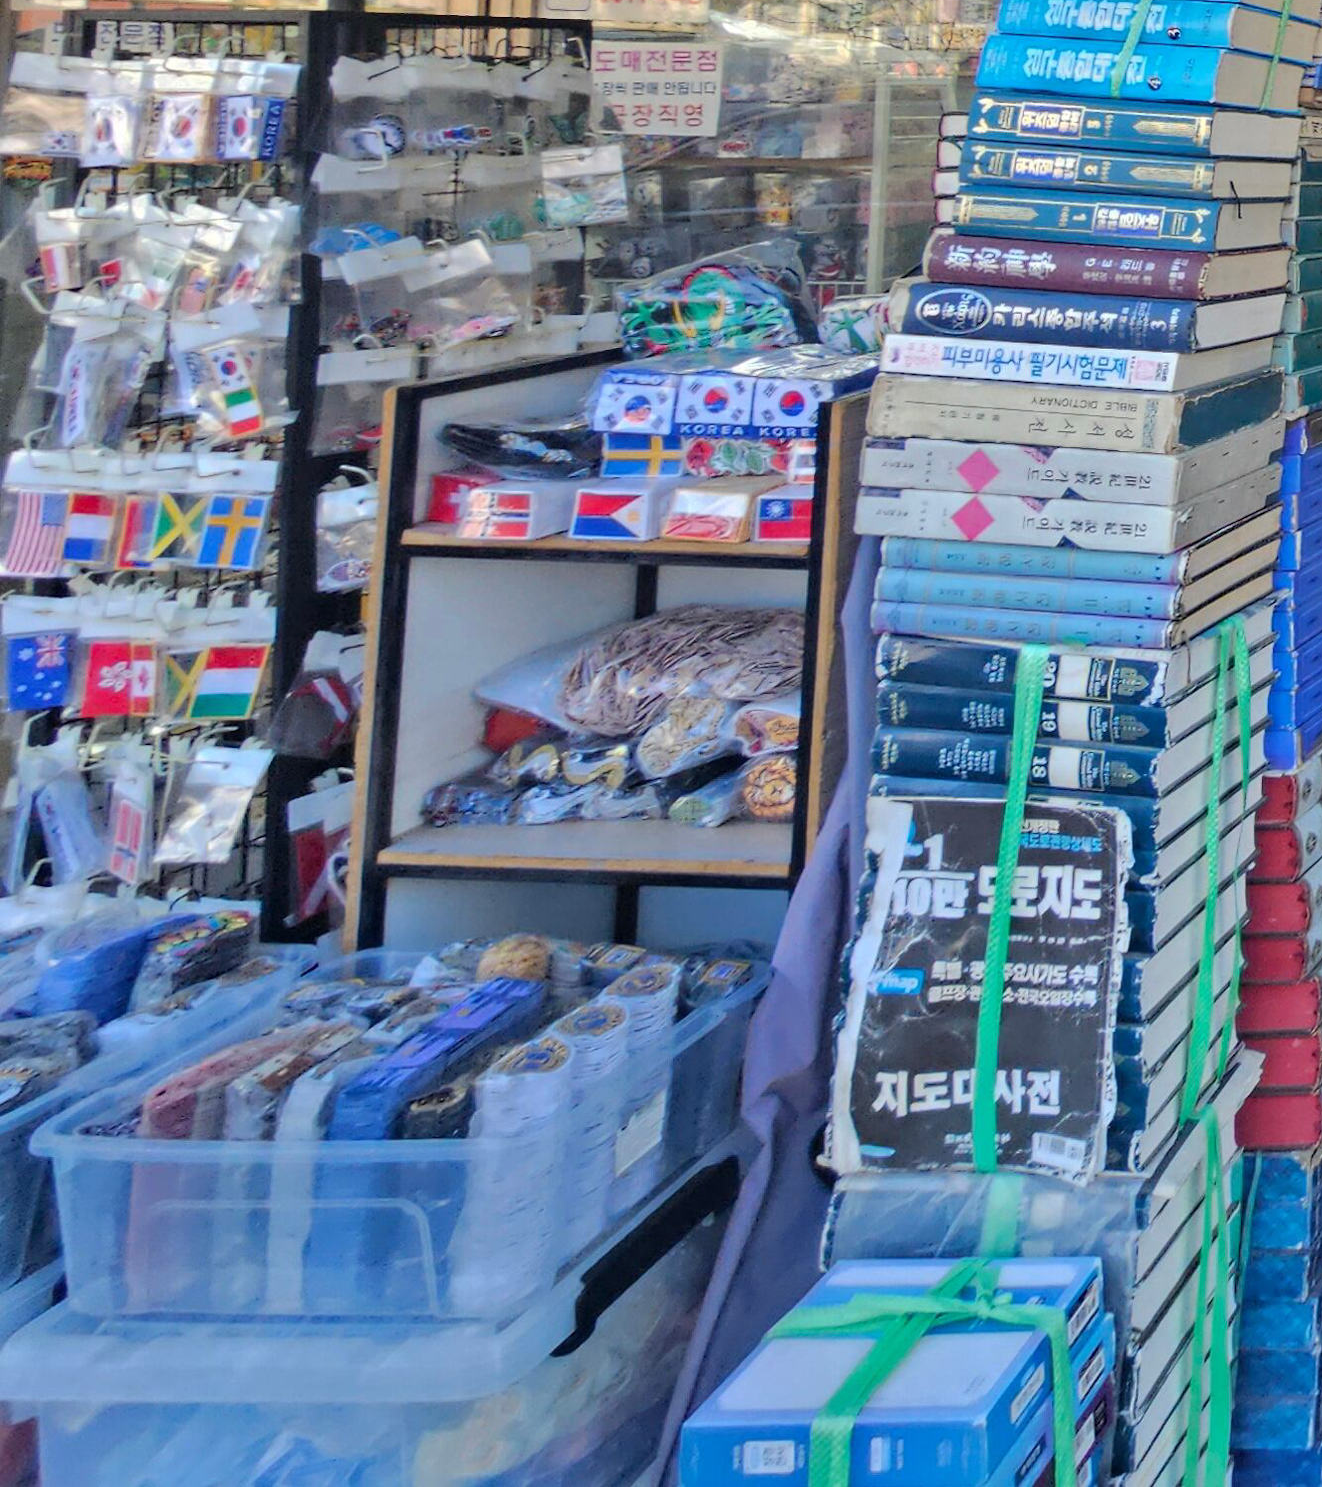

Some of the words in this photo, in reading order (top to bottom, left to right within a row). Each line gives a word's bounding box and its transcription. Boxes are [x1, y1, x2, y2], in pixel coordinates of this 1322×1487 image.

[594, 49, 718, 73] 도매전문점
[1022, 47, 1147, 85] 성구종합대전
[595, 82, 628, 97] 장씩
[632, 82, 660, 97] 판매
[663, 81, 717, 97] 안됩니다
[992, 305, 1118, 331] 카리스종합주석
[941, 345, 1025, 375] 피부미용사
[1028, 351, 1128, 381] 필기시험문제
[1031, 395, 1099, 412] DICTIONARY
[1104, 400, 1138, 413] BIBLE
[680, 424, 745, 436] KOREA
[758, 426, 818, 438] KORE
[1039, 711, 1056, 735] 19
[977, 864, 1103, 921] 도로지도
[871, 1068, 1061, 1118] 지도대사전
